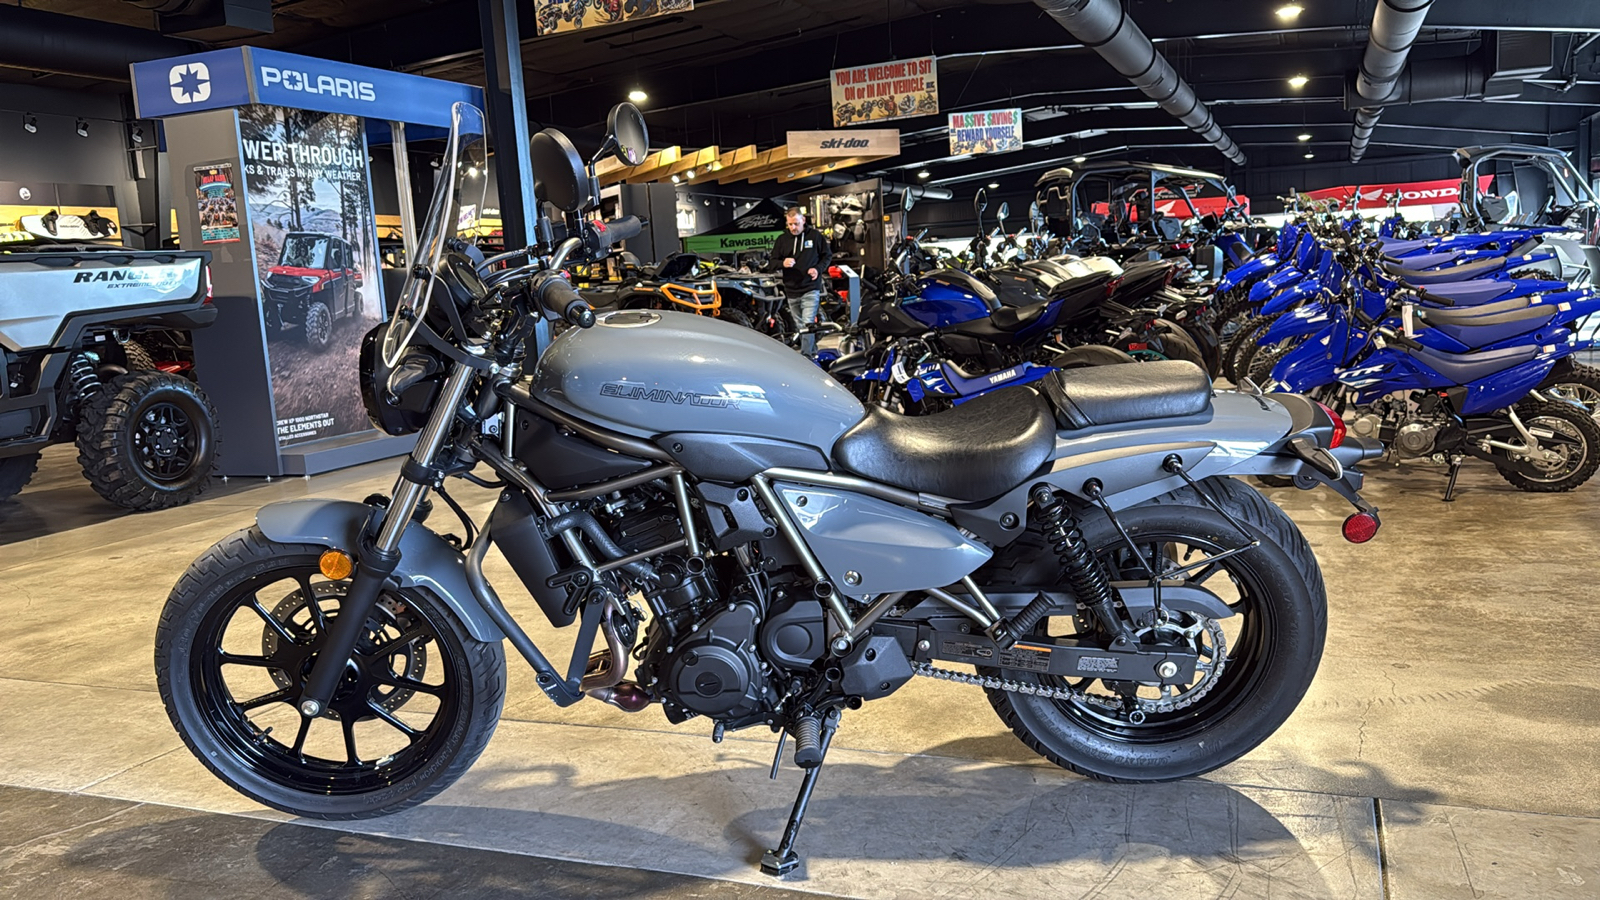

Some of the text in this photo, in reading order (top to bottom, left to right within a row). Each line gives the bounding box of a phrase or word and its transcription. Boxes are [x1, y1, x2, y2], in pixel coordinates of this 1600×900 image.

[835, 59, 932, 86] YOU ARE WELCOME TO SIT
[260, 66, 376, 102] POLARIS
[844, 86, 855, 101] ON
[856, 87, 866, 99] or
[866, 84, 875, 98] IN
[876, 81, 892, 97] ANY
[892, 77, 924, 94] VEHICLE
[957, 127, 984, 143] REWARD
[984, 125, 1015, 141] YOURSELF
[819, 137, 870, 149] ski-doo
[242, 138, 364, 169] WER THROUGH
[256, 165, 264, 176] &
[265, 166, 296, 178] TRAILS
[297, 168, 306, 178] IN
[307, 169, 323, 179] ANY
[324, 169, 362, 181] WEATHER
[1383, 187, 1461, 201] HOND
[720, 235, 774, 249] Kawasaki
[106, 281, 153, 289] EXTREME
[988, 369, 1017, 385] YAMAHA
[599, 383, 741, 410] ELIMINATOR
[289, 420, 323, 433] ELEMENTS
[322, 417, 335, 427] OUT
